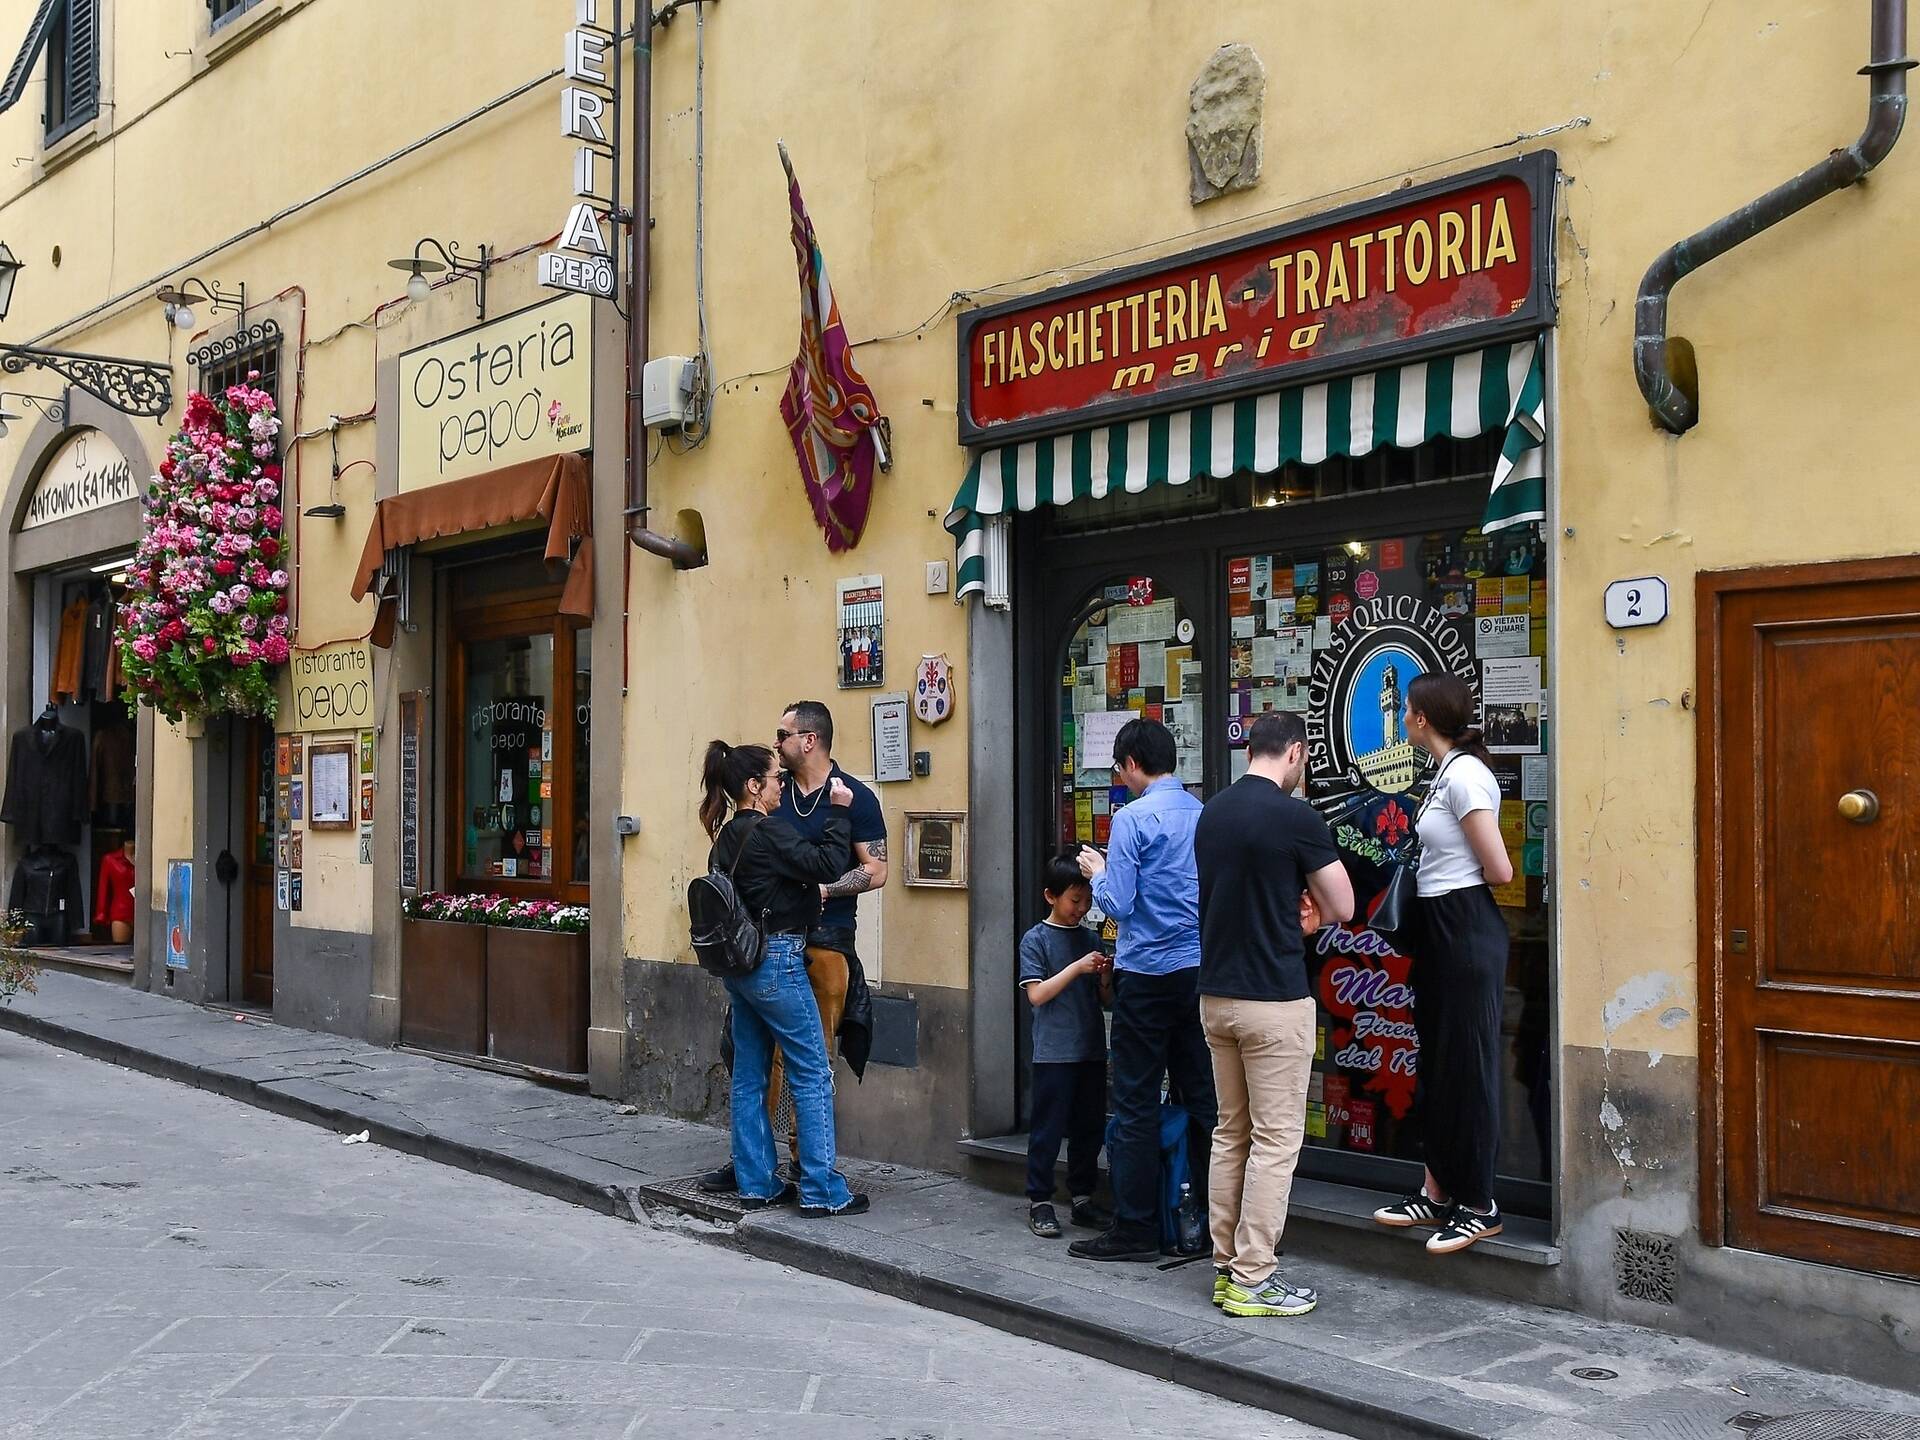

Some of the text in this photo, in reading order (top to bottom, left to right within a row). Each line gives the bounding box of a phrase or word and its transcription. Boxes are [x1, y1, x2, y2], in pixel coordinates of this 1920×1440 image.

[549, 255, 614, 295] PEPÒ
[983, 273, 1229, 388] FIASCHETTERIA
[1269, 197, 1517, 319] TRATTORIA
[414, 322, 575, 408] Osteria
[1112, 323, 1325, 390] mario
[439, 387, 542, 474] pepò
[30, 461, 130, 523] ANTONIO LEATHER
[932, 567, 941, 587] 2
[1494, 615, 1525, 625] VIETATO
[1626, 589, 1642, 618] 2
[1494, 624, 1526, 634] FUMARE
[295, 650, 367, 677] ristorante
[298, 679, 369, 727] pepò
[1304, 650, 1339, 775] ESERCIZI
[1329, 594, 1423, 654] STORICI
[472, 700, 546, 732] ristorante
[1316, 922, 1402, 957] Tra
[1334, 1043, 1419, 1076] dal 19
